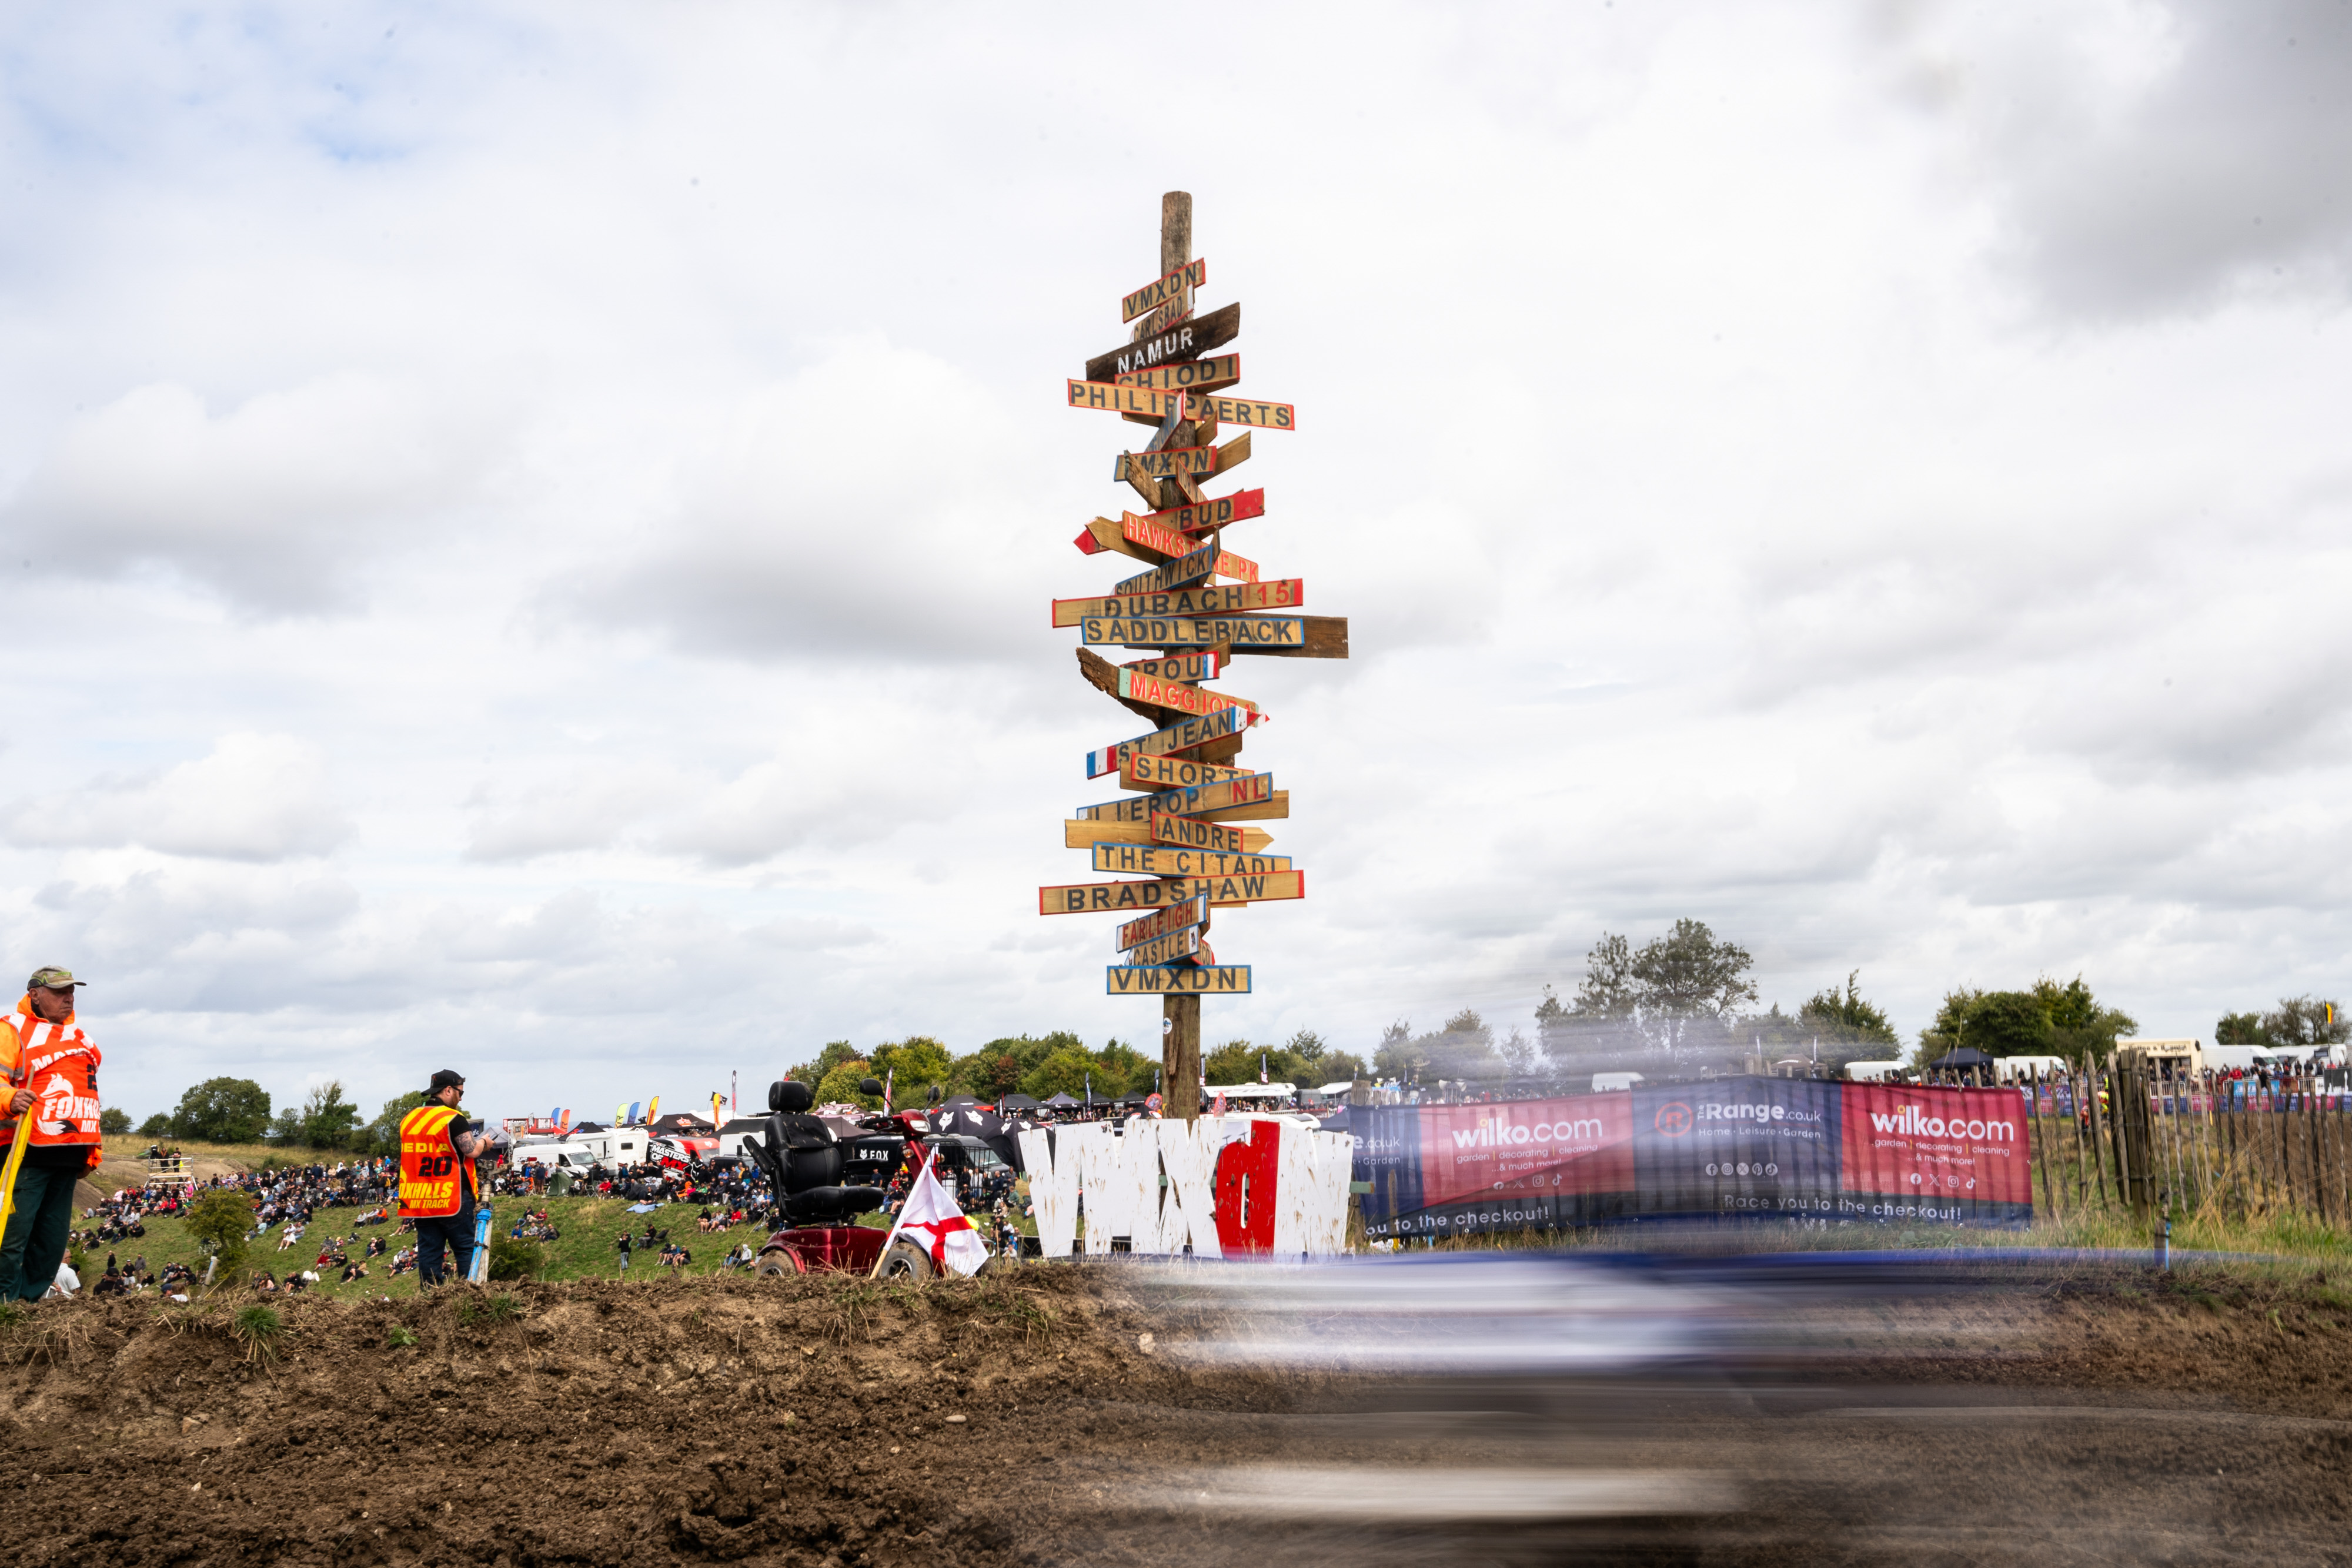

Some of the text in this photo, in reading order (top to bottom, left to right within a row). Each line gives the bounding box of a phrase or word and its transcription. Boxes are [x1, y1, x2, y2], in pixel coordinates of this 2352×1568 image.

[1126, 263, 1197, 316] VMXDN
[1134, 296, 1182, 342] CARLSBAD
[1118, 327, 1193, 375] NAMUR
[1135, 449, 1209, 474] MXDN
[1180, 499, 1232, 530] BUD
[1127, 515, 1258, 583] HAWKSTE PK
[1117, 550, 1206, 595] SOUTHWICK
[1105, 584, 1289, 617] DUBACH 15
[1087, 620, 1293, 642] SADDLEBACK
[1119, 711, 1231, 763] ST JEAN
[1137, 757, 1238, 785] SHORT
[1233, 777, 1267, 803] NL
[1161, 817, 1239, 852] ANDRE
[1101, 845, 1155, 871] THE
[1068, 875, 1265, 911] BRADSHAW
[1122, 901, 1192, 947] FARLEIGH
[1133, 932, 1184, 965] CASTLE
[1114, 967, 1235, 991] VMXDN
[1706, 1103, 1821, 1123] Range.co.uk
[1870, 1105, 2014, 1142] wilko.com
[81, 1120, 97, 1133] MX
[1452, 1117, 1603, 1148] wilko.com
[1699, 1126, 1820, 1139] Home Leisure Garden
[401, 1142, 451, 1153] EDIA
[651, 1144, 691, 1163] MASTERS
[870, 1150, 888, 1161] FOX
[1363, 1156, 1401, 1165] Garden
[1456, 1144, 1598, 1164] garden decorating cleaning
[1875, 1139, 2010, 1158] garden decorating cleaning
[1925, 1154, 1949, 1164] much
[1951, 1156, 1975, 1165] more!
[418, 1156, 453, 1177] 20
[652, 1152, 664, 1161] OF
[660, 1156, 690, 1171] MX
[1508, 1160, 1534, 1171] much
[1536, 1158, 1562, 1168] more!
[399, 1181, 454, 1199] OXHILLS
[409, 1199, 451, 1209] MX TRACK
[1725, 1195, 1962, 1221] Race you to the checkout!
[1365, 1206, 1549, 1235] ou to the checkout!
